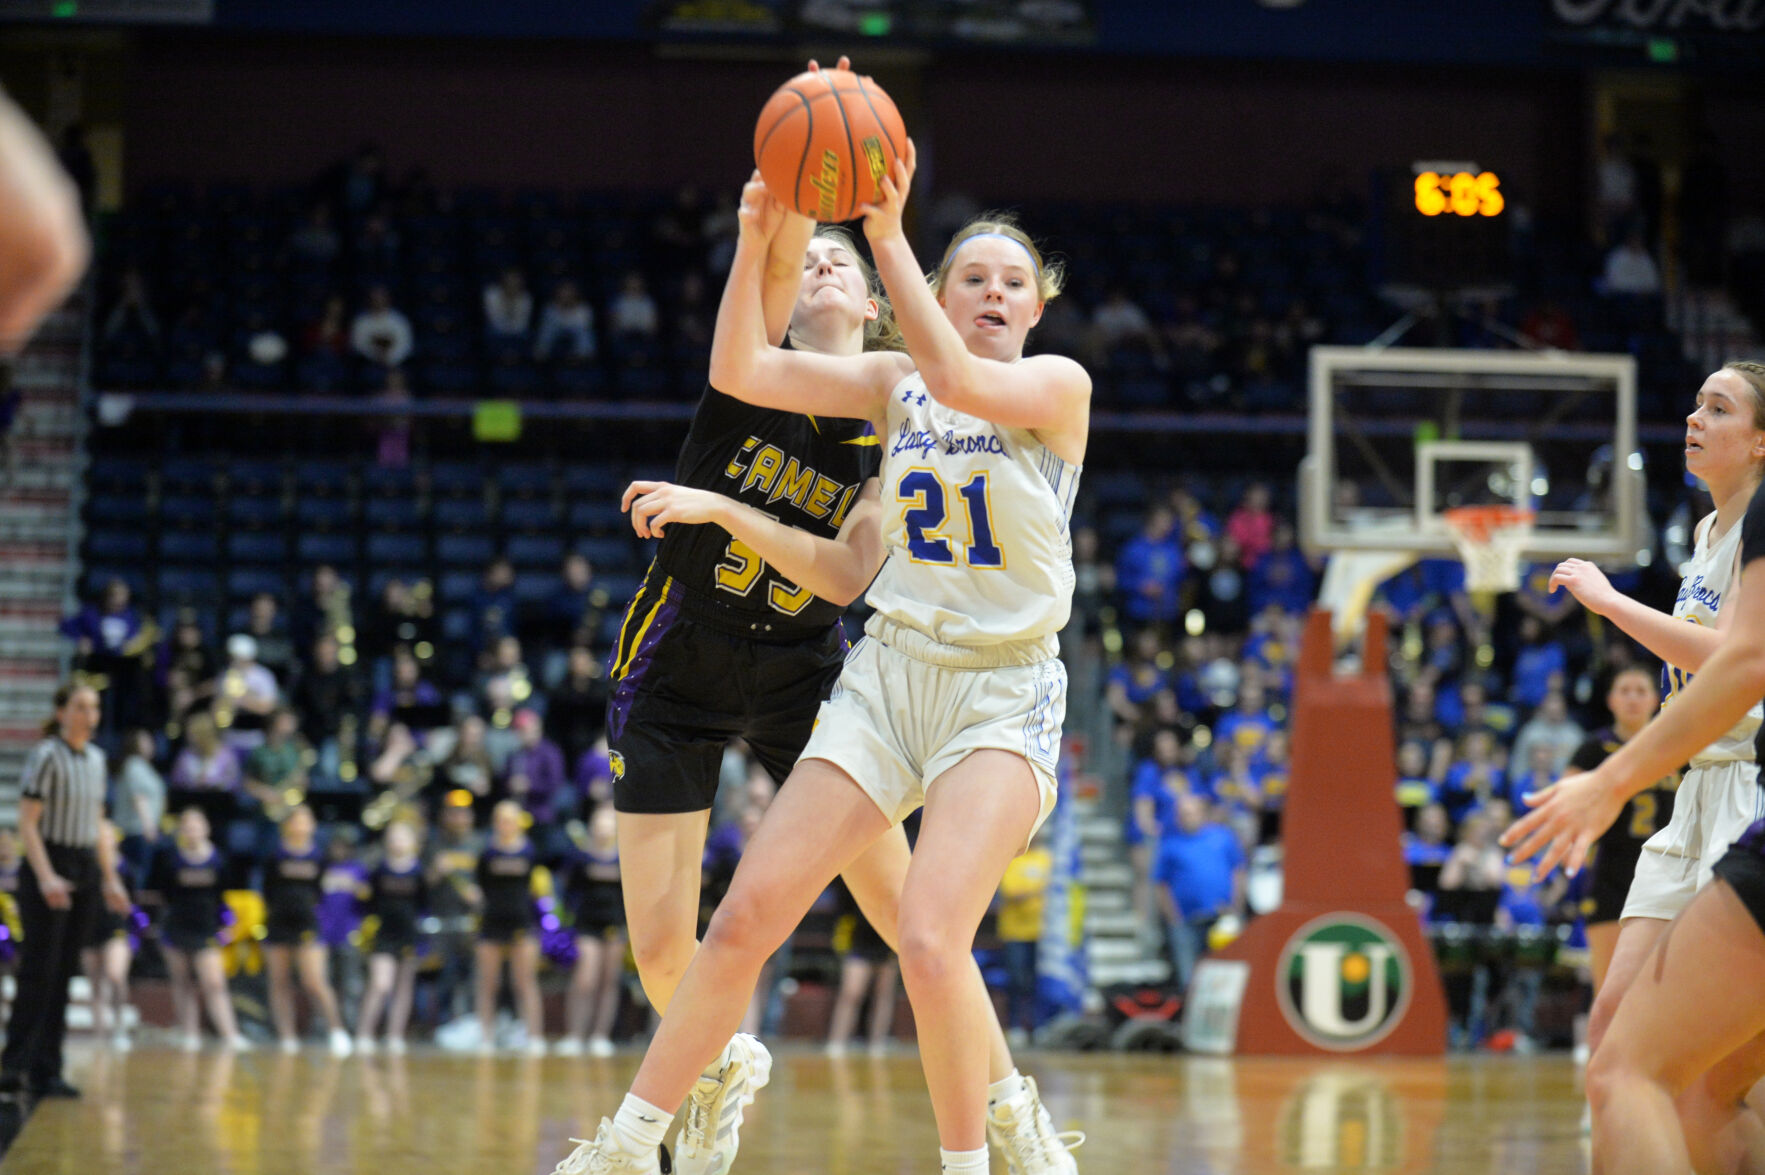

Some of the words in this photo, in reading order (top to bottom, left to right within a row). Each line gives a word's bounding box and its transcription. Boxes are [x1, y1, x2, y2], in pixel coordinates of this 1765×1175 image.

[1415, 171, 1504, 216] 6:05
[896, 466, 1006, 570] 21
[1295, 940, 1395, 1036] U
